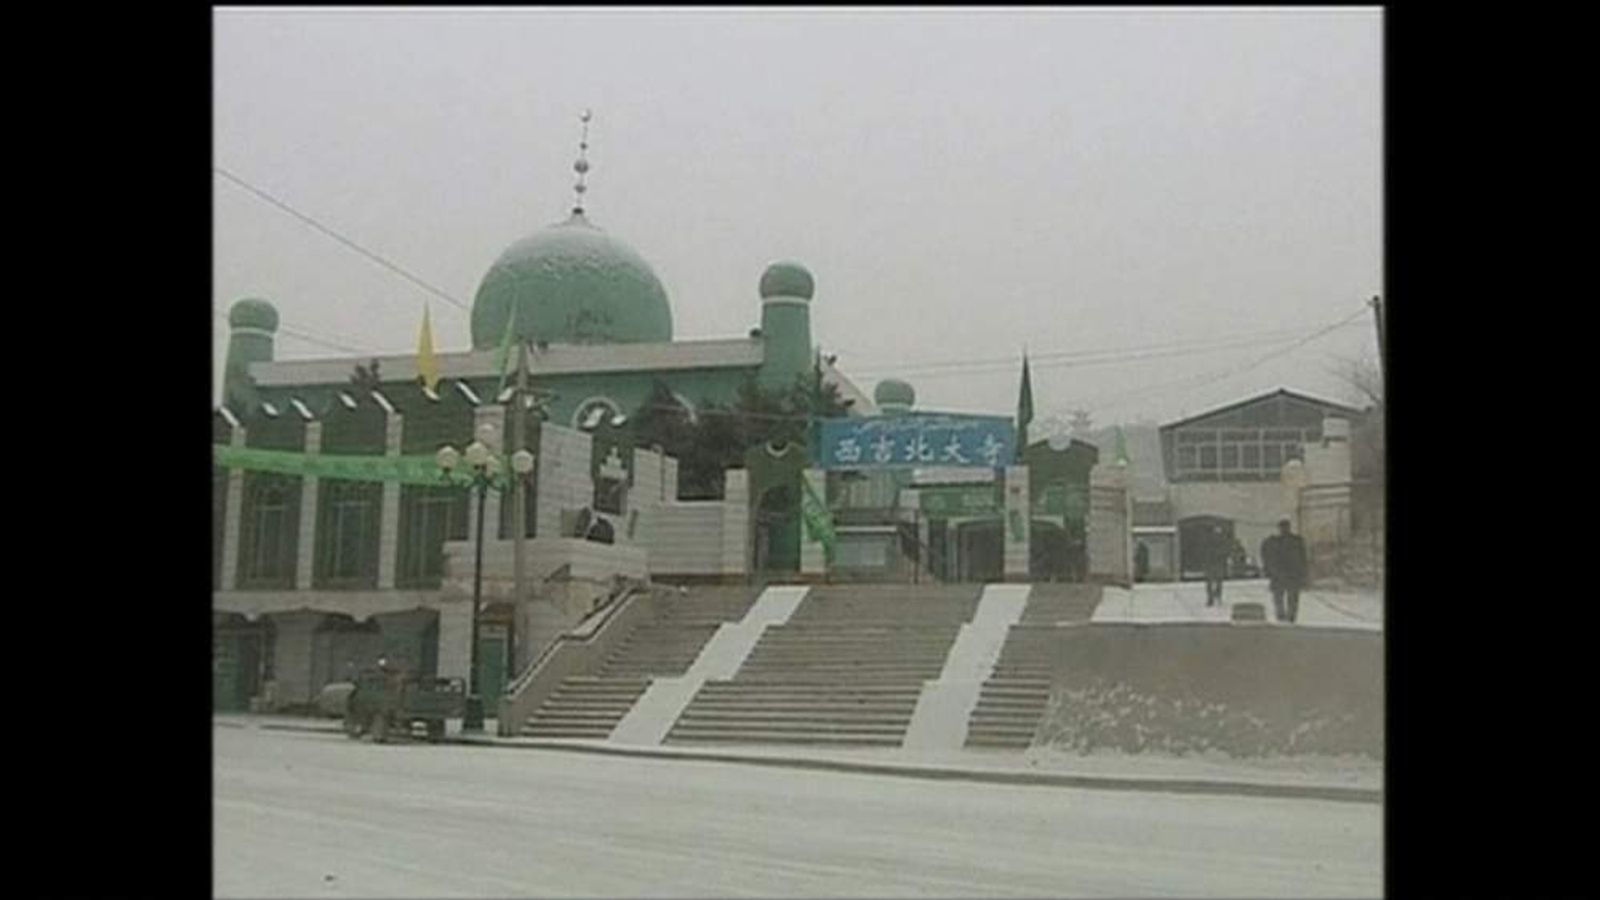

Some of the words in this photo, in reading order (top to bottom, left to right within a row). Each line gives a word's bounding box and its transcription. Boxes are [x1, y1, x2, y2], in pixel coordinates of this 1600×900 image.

[834, 434, 1004, 465] 西吉北大寺
